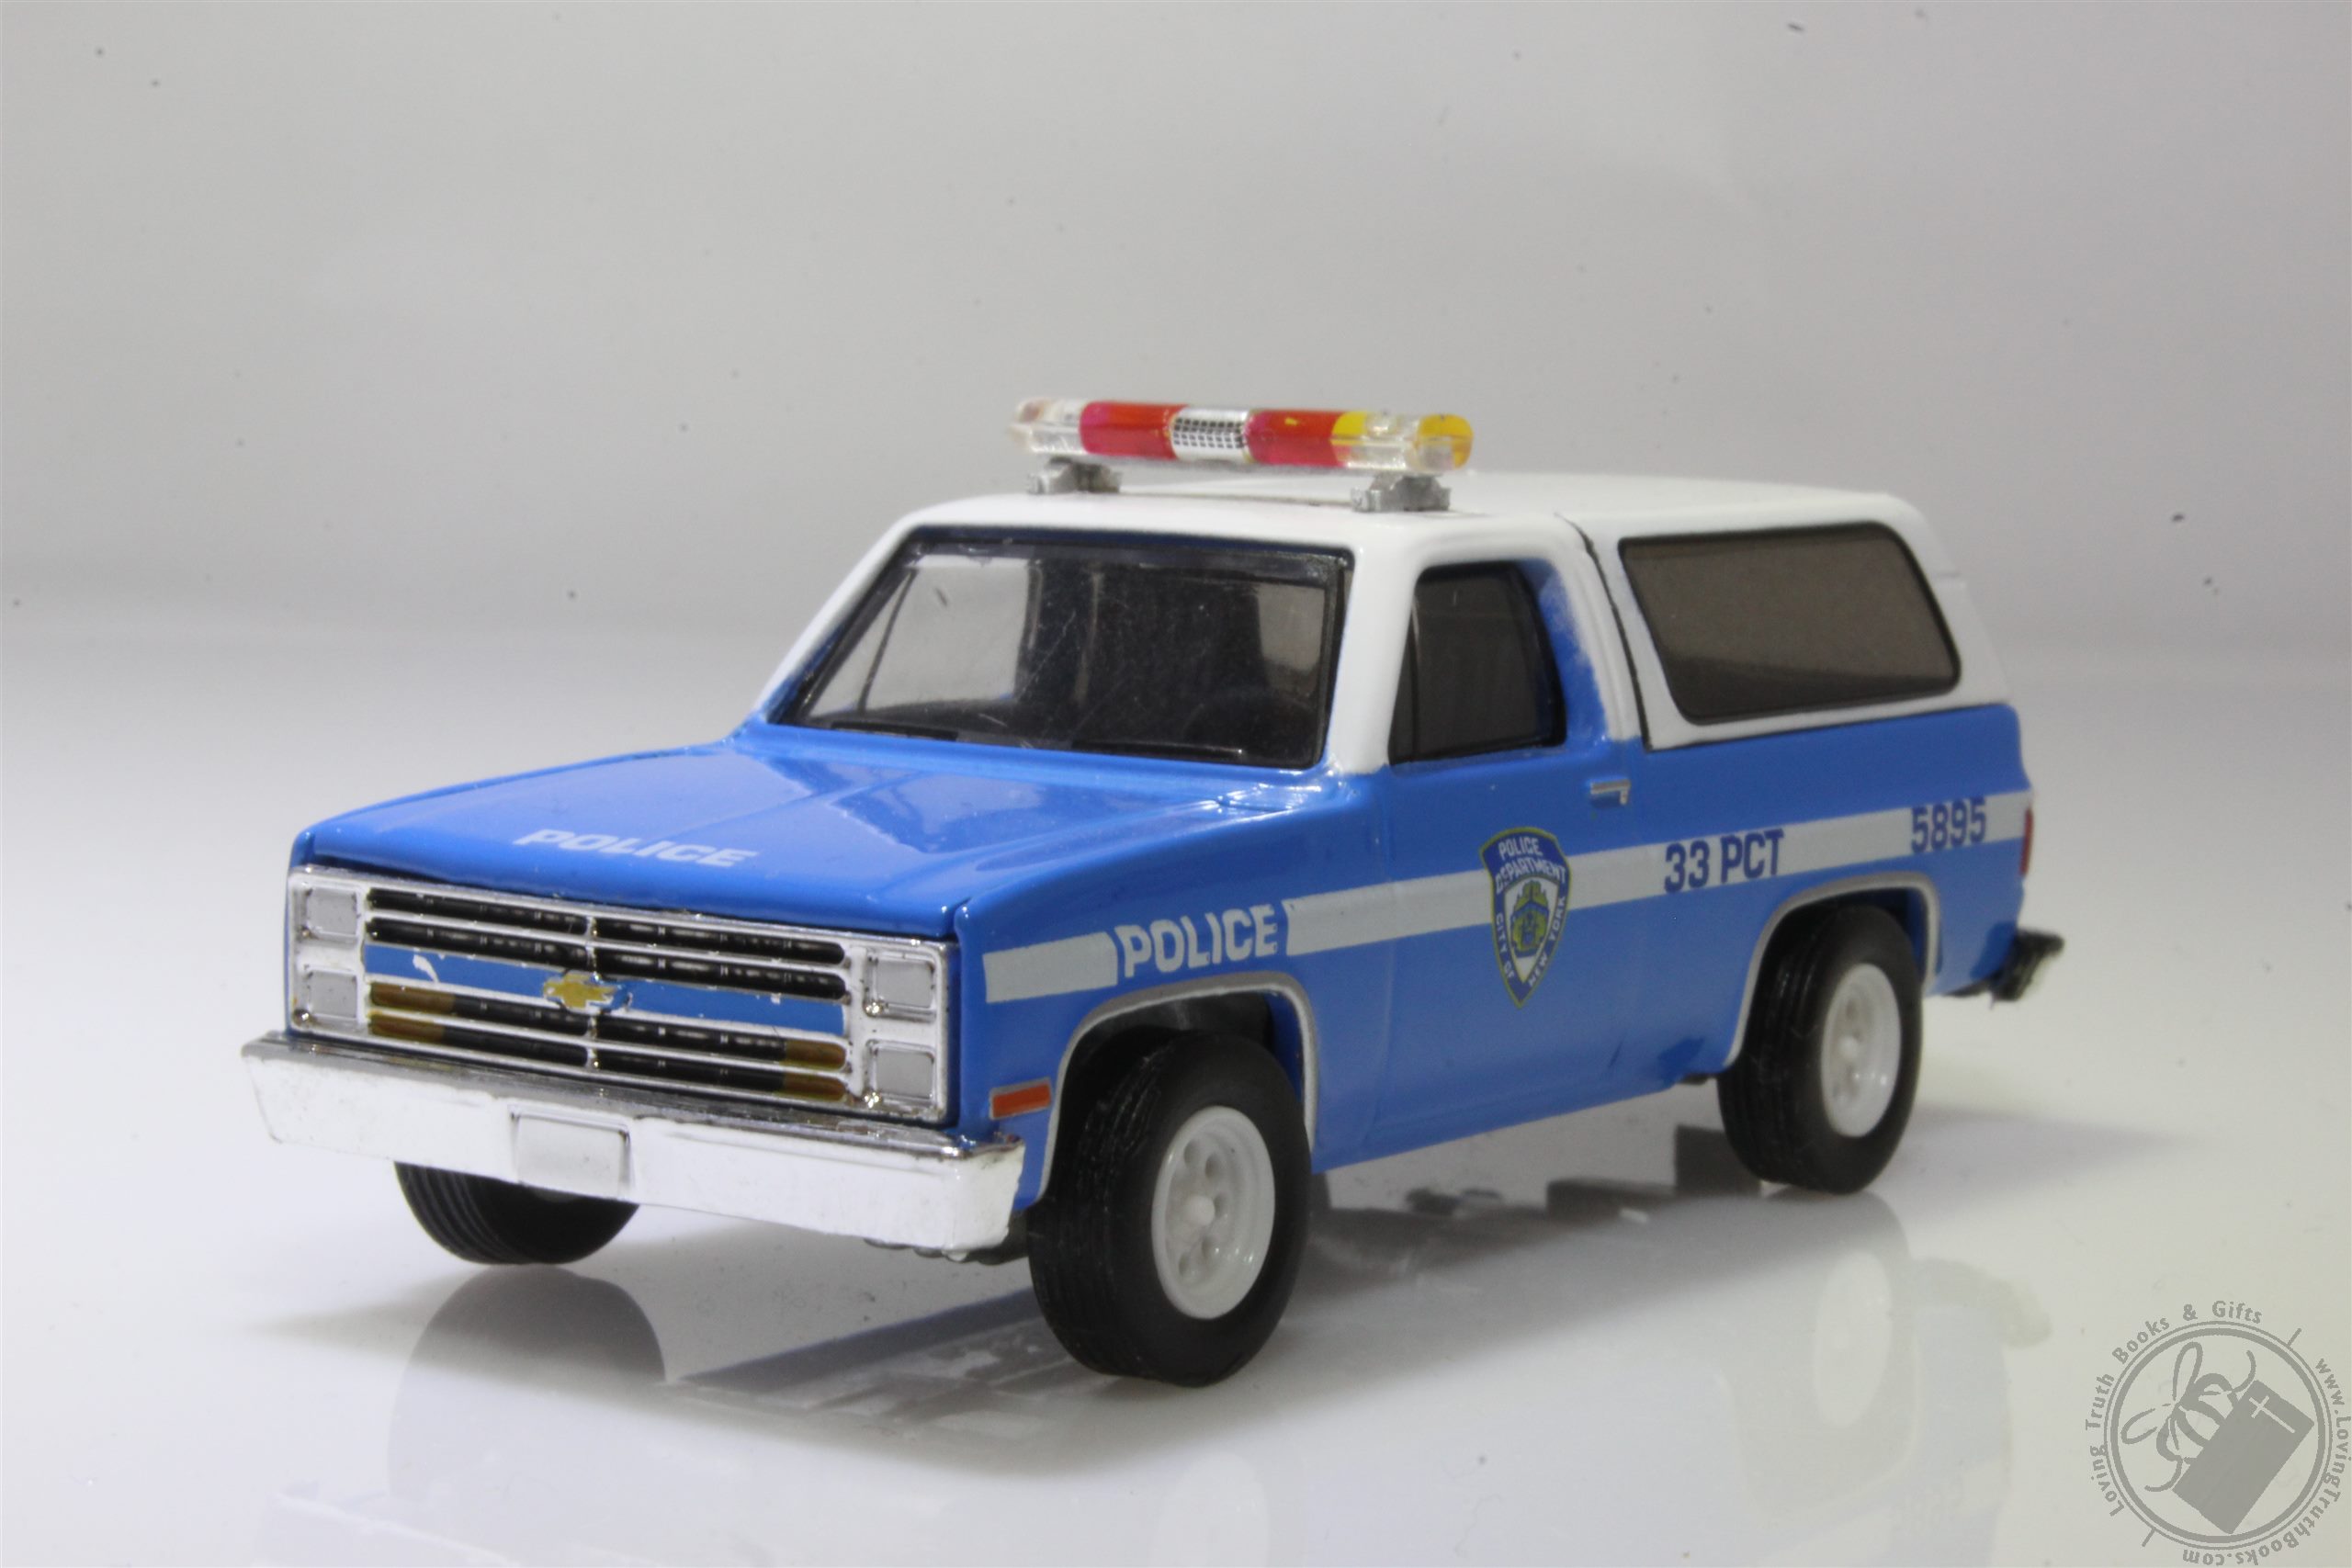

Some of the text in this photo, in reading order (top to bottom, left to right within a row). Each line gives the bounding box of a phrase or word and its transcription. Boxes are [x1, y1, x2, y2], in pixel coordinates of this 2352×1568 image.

[512, 829, 760, 867] POLICE
[1498, 837, 1543, 860] POLICE
[1911, 796, 1987, 854] 5895
[1495, 858, 1566, 895] DEPARTMENT
[1664, 829, 1784, 894] 33 PCT
[1114, 904, 1278, 978] POLICE
[1496, 897, 1566, 986] CITY OF NEW YORK
